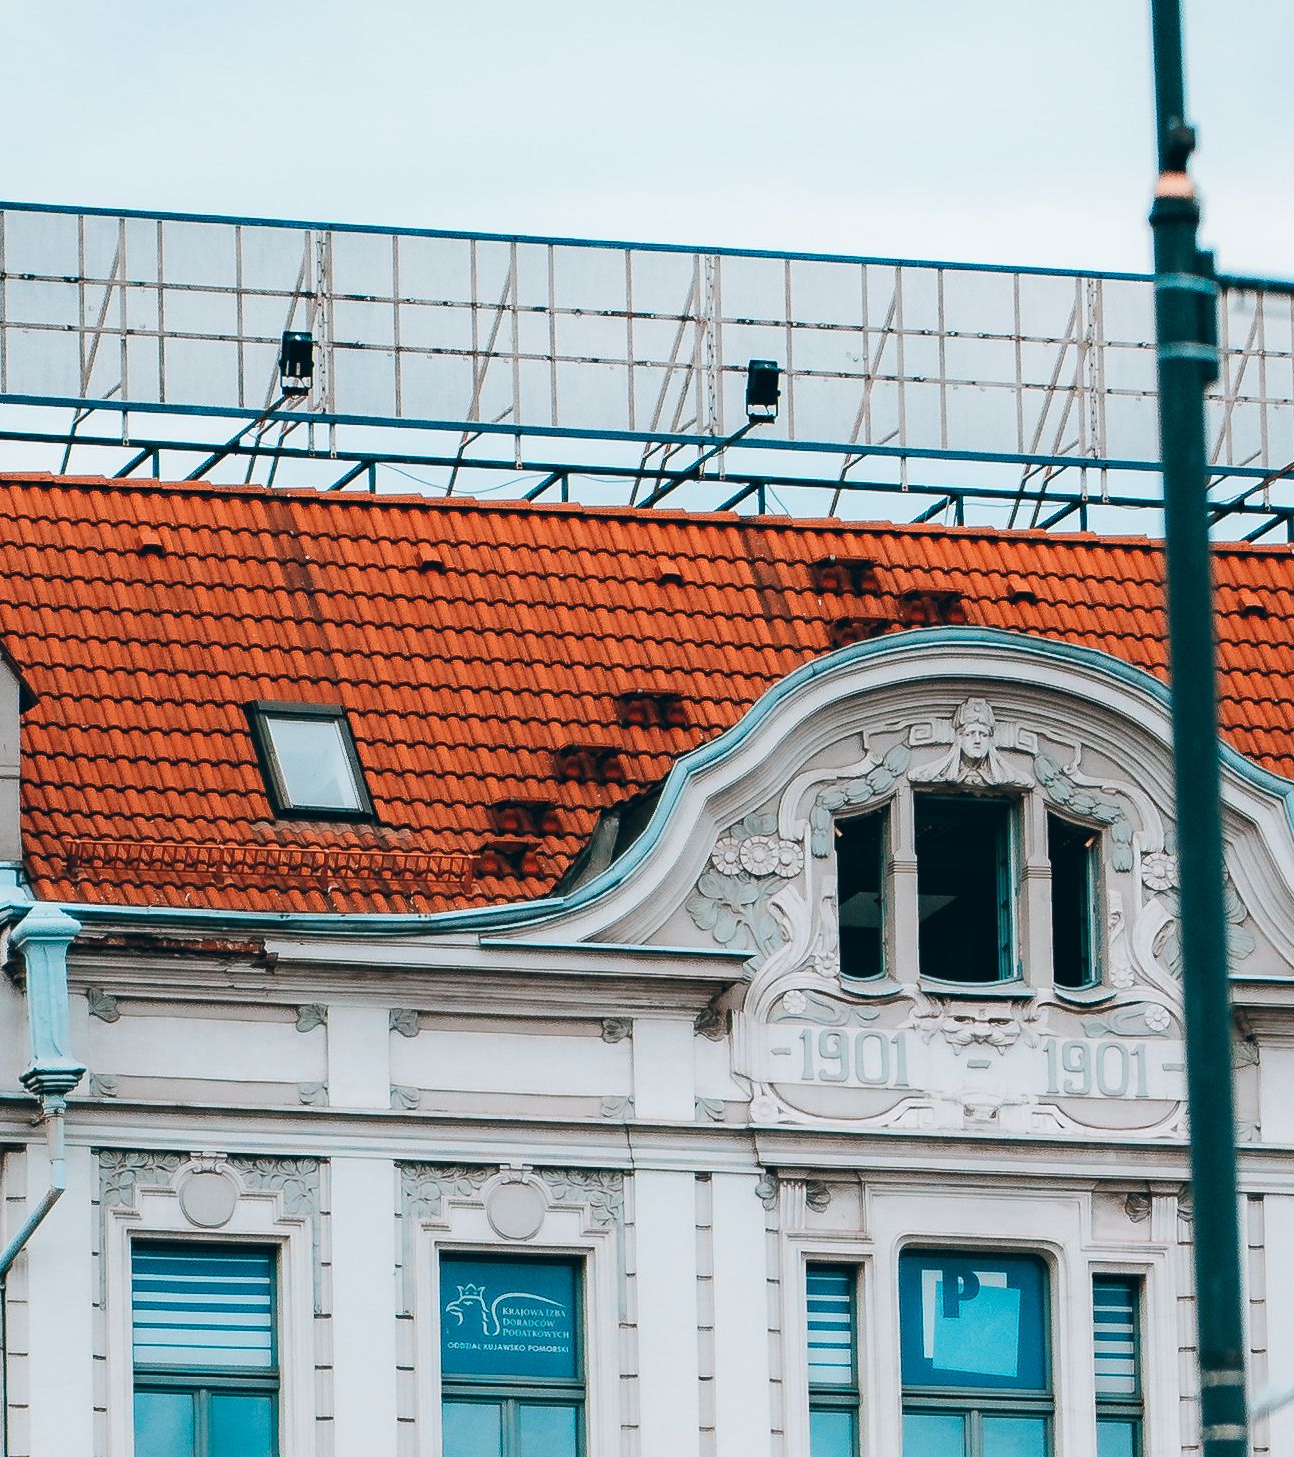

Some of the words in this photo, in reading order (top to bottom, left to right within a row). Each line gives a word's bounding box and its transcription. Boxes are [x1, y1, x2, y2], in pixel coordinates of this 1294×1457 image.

[798, 1027, 910, 1087] 1901
[1042, 1037, 1150, 1098] 1901
[502, 1307, 544, 1317] KRAJOWA
[546, 1309, 566, 1317] IZBA
[502, 1329, 570, 1339] PODATKOWYCH
[483, 1344, 526, 1352] KUJAWSKO
[528, 1345, 569, 1353] POMORSKI
